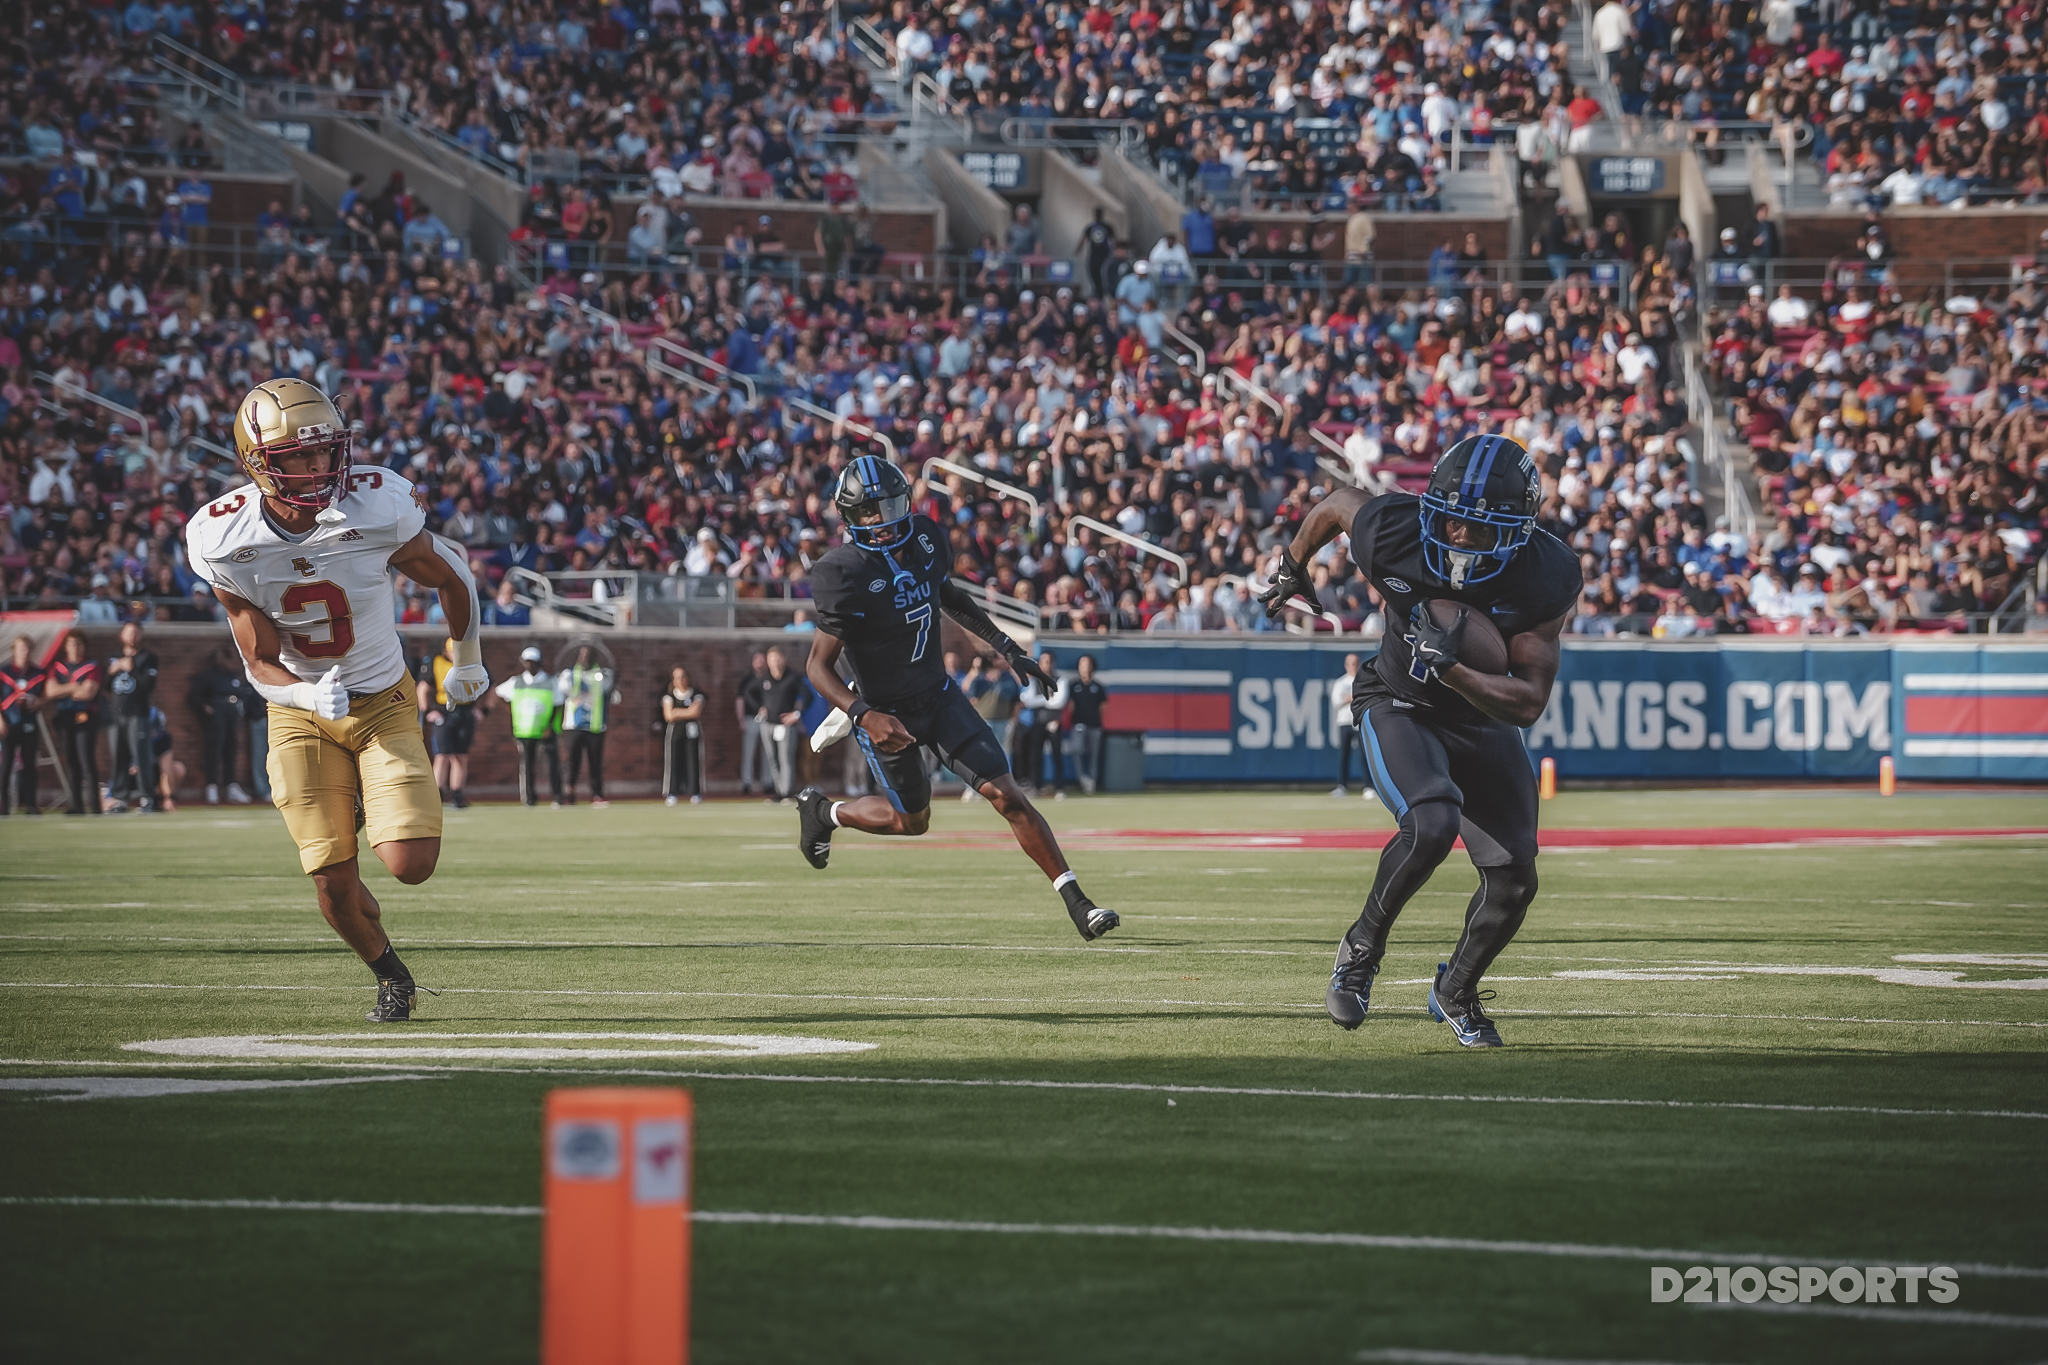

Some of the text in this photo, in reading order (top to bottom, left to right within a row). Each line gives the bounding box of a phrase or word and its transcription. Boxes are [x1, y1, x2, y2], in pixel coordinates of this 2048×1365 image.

[349, 471, 384, 493] 3
[208, 494, 248, 519] 3
[234, 548, 255, 561] ACC
[917, 533, 935, 554] C
[893, 580, 932, 609] SMU
[280, 579, 355, 659] 3
[905, 602, 933, 663] 7
